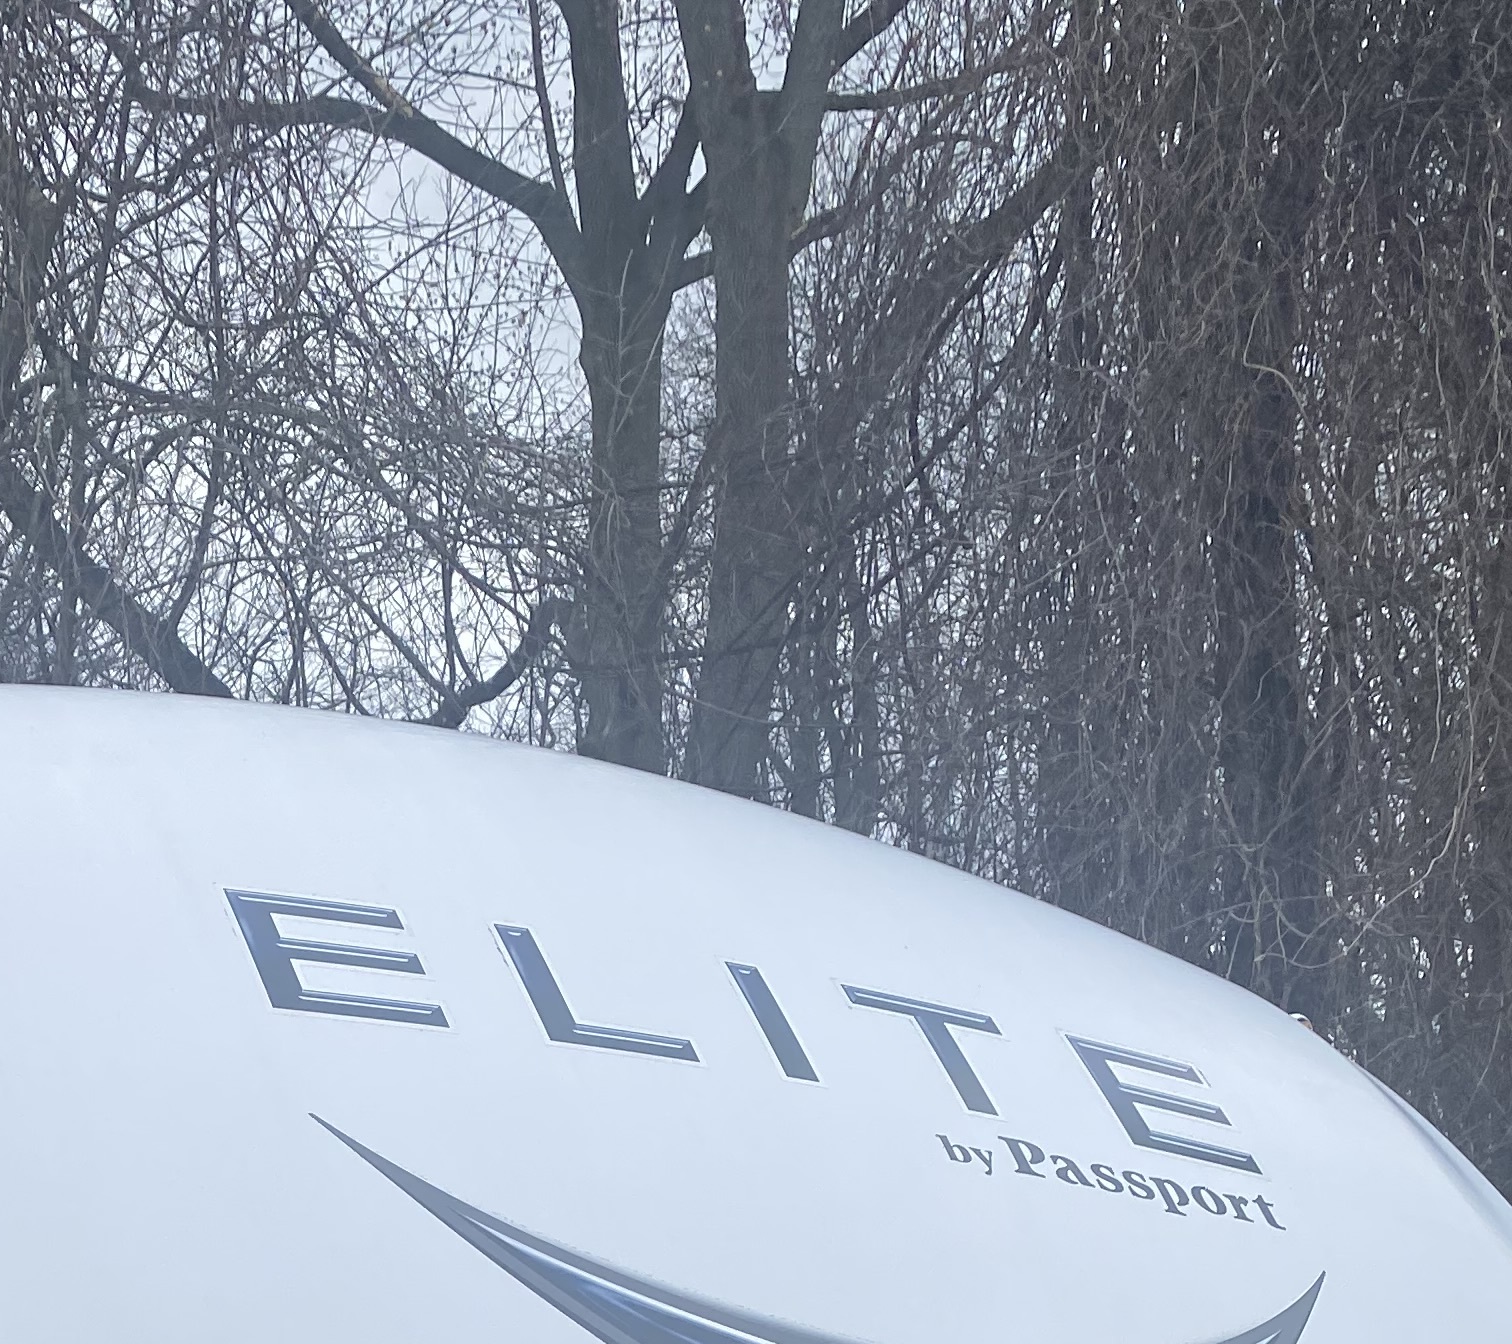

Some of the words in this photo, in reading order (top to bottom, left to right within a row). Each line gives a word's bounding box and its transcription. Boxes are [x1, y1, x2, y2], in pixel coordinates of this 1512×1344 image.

[222, 886, 1264, 1176] ELITE
[935, 1133, 993, 1176] by
[997, 1135, 1287, 1231] Passport
